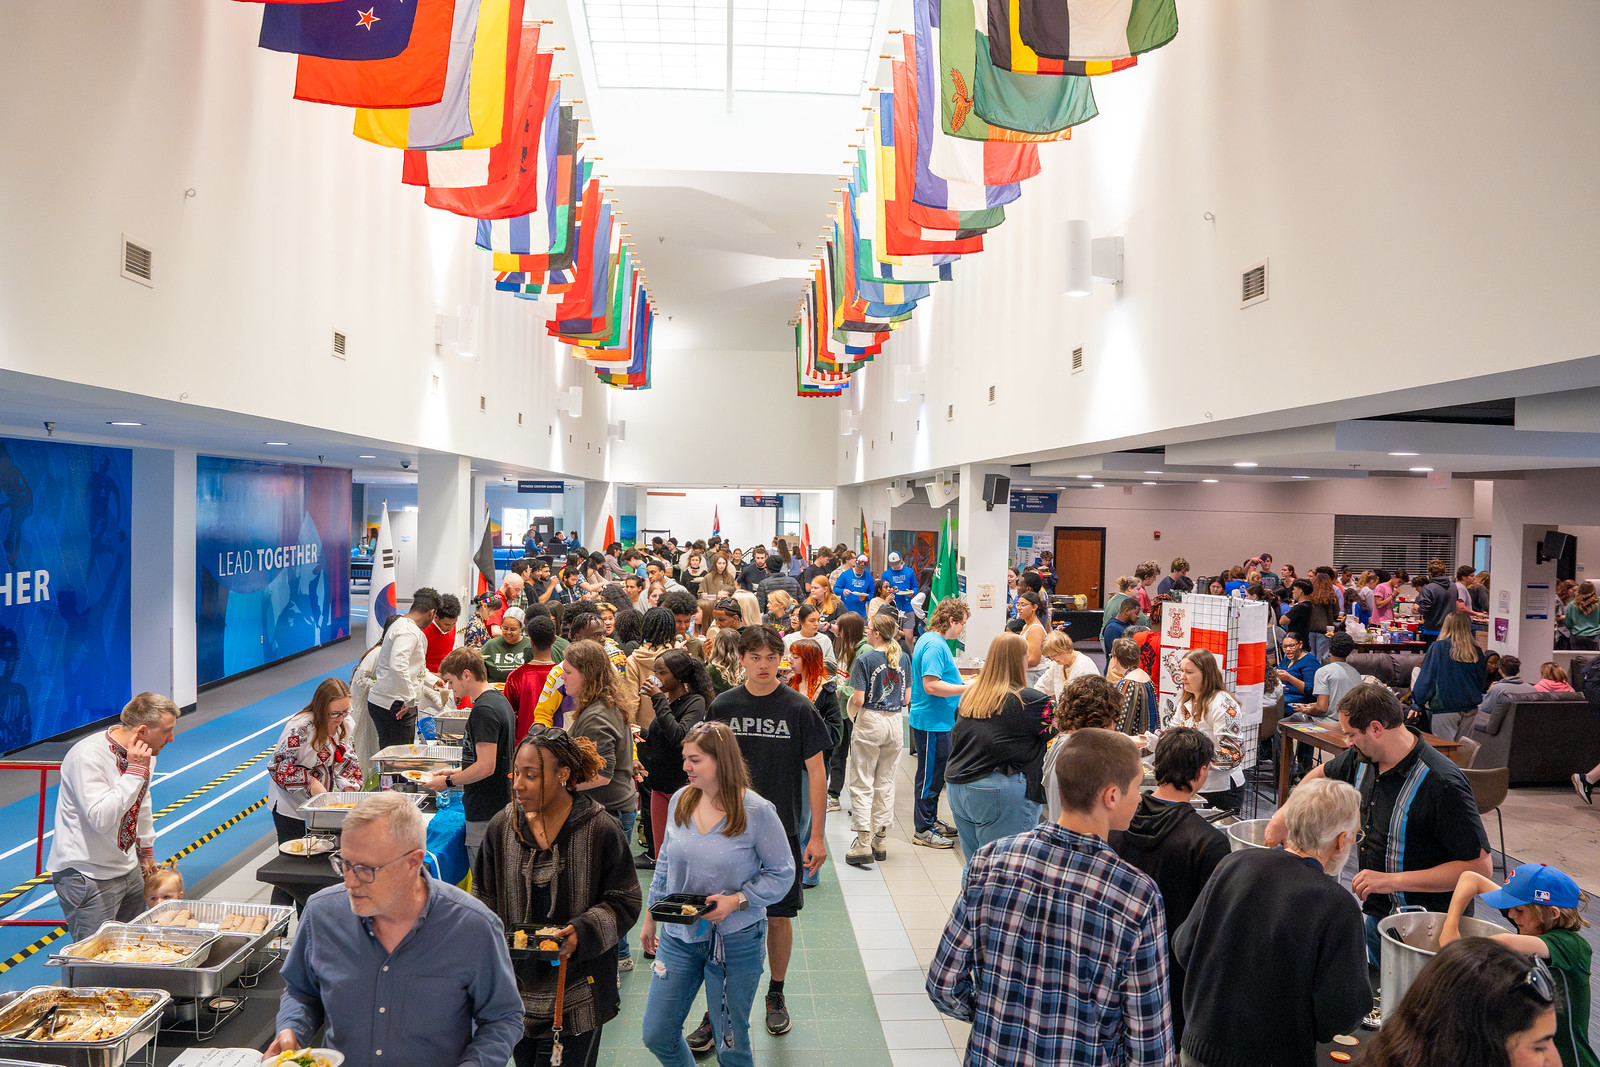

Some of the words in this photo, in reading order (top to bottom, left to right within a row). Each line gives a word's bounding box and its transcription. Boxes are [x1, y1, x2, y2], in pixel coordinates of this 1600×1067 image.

[218, 549, 253, 577] LEAD
[256, 543, 318, 572] TOGETHER
[729, 717, 791, 735] APISA
